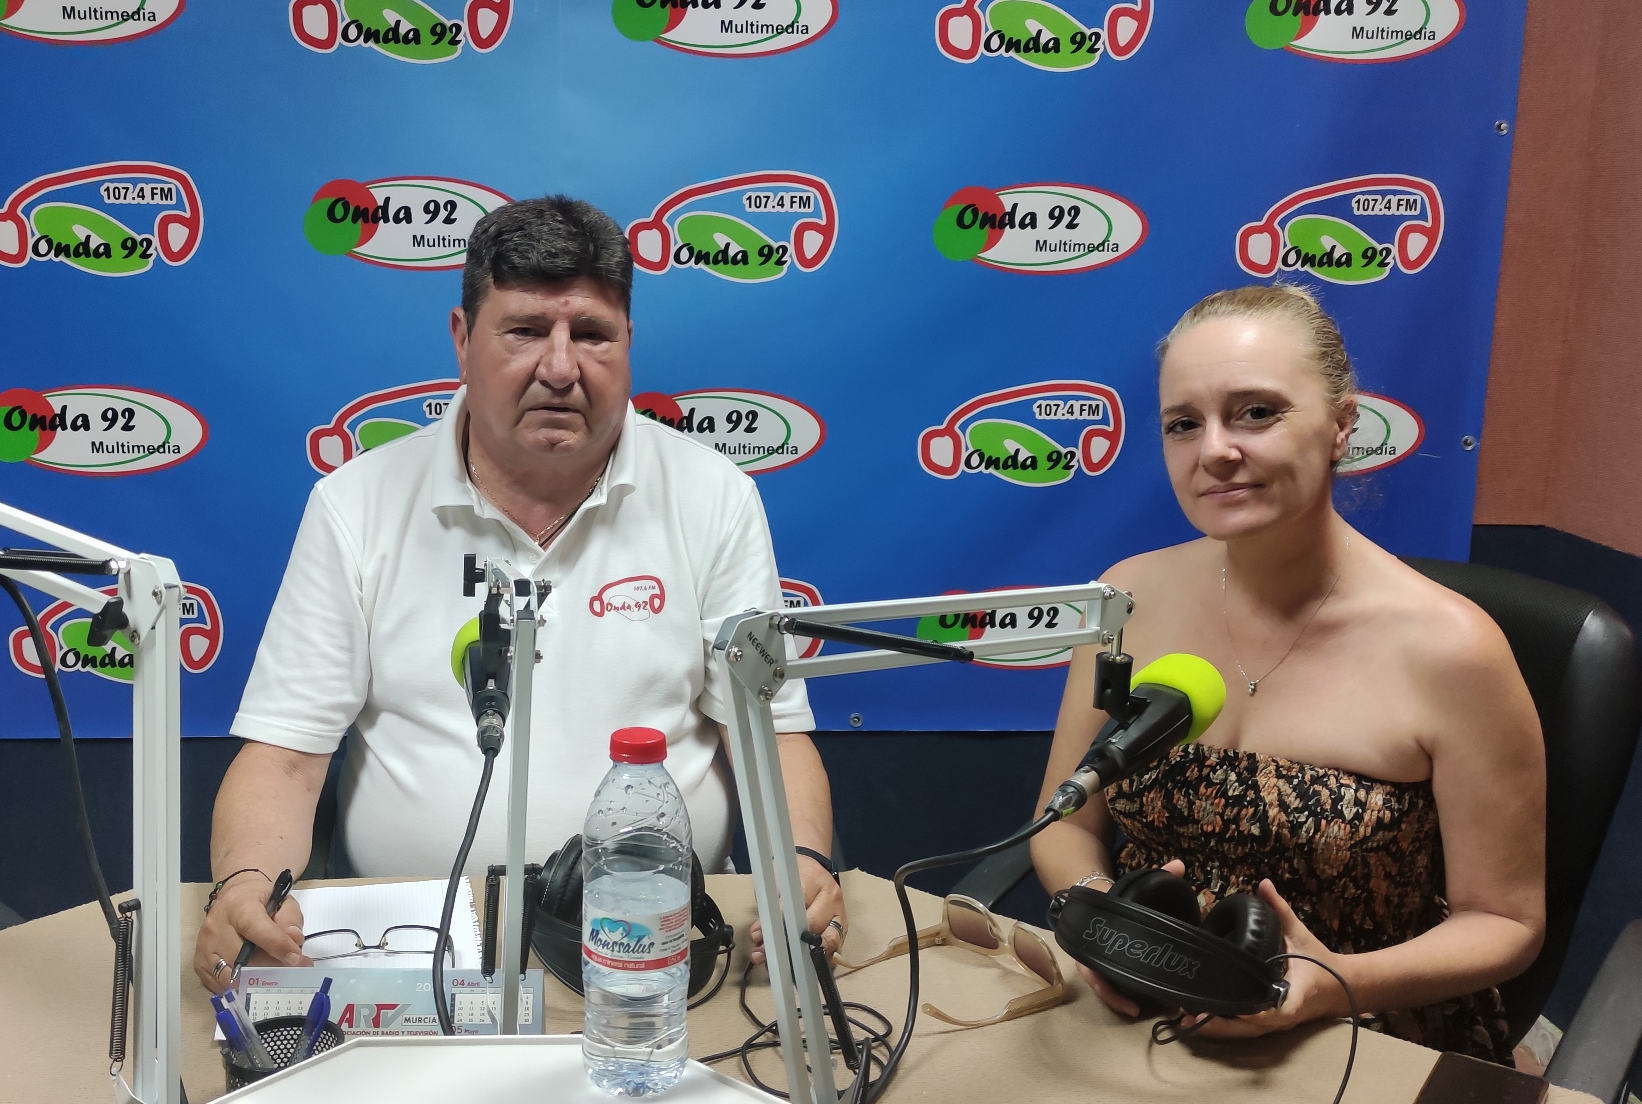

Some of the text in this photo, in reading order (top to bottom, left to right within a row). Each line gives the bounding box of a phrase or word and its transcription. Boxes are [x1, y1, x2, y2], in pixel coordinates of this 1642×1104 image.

[61, 5, 157, 22] Multimedia
[340, 19, 463, 47] Onda 92
[719, 19, 810, 35] Multimedia
[1351, 26, 1437, 41] Multimedia
[983, 28, 1102, 55] Onda 92
[103, 185, 173, 202] 107.4 FM
[745, 194, 811, 210] 107.4 FM
[1354, 194, 1418, 212] 107.4 FM
[326, 196, 458, 225] Onda 92
[955, 202, 1081, 231] Onda 92
[31, 234, 153, 260] Onda 92
[412, 234, 467, 249] Multim
[1034, 239, 1120, 255] Multimedia
[673, 242, 789, 267] Onda 92
[1281, 244, 1392, 269] Onda 92
[3, 404, 136, 432] Onda 92
[1036, 403, 1100, 417] 107.4 FM
[725, 409, 759, 434] 92
[90, 440, 181, 455] Multimedia
[714, 443, 799, 456] Multimedia
[1347, 443, 1397, 456] imedia
[964, 448, 1077, 471] Onda 92
[606, 600, 649, 612] Onda 92
[1027, 606, 1060, 629] 92
[59, 645, 134, 669] Onda
[746, 631, 775, 668] NEEWER
[588, 927, 656, 955] Monssalus
[1082, 916, 1201, 980] Superlux
[602, 957, 623, 969] mineral
[623, 962, 646, 970] natural
[248, 977, 260, 986] 01
[452, 978, 465, 987] 04
[336, 1003, 412, 1029] ARTV
